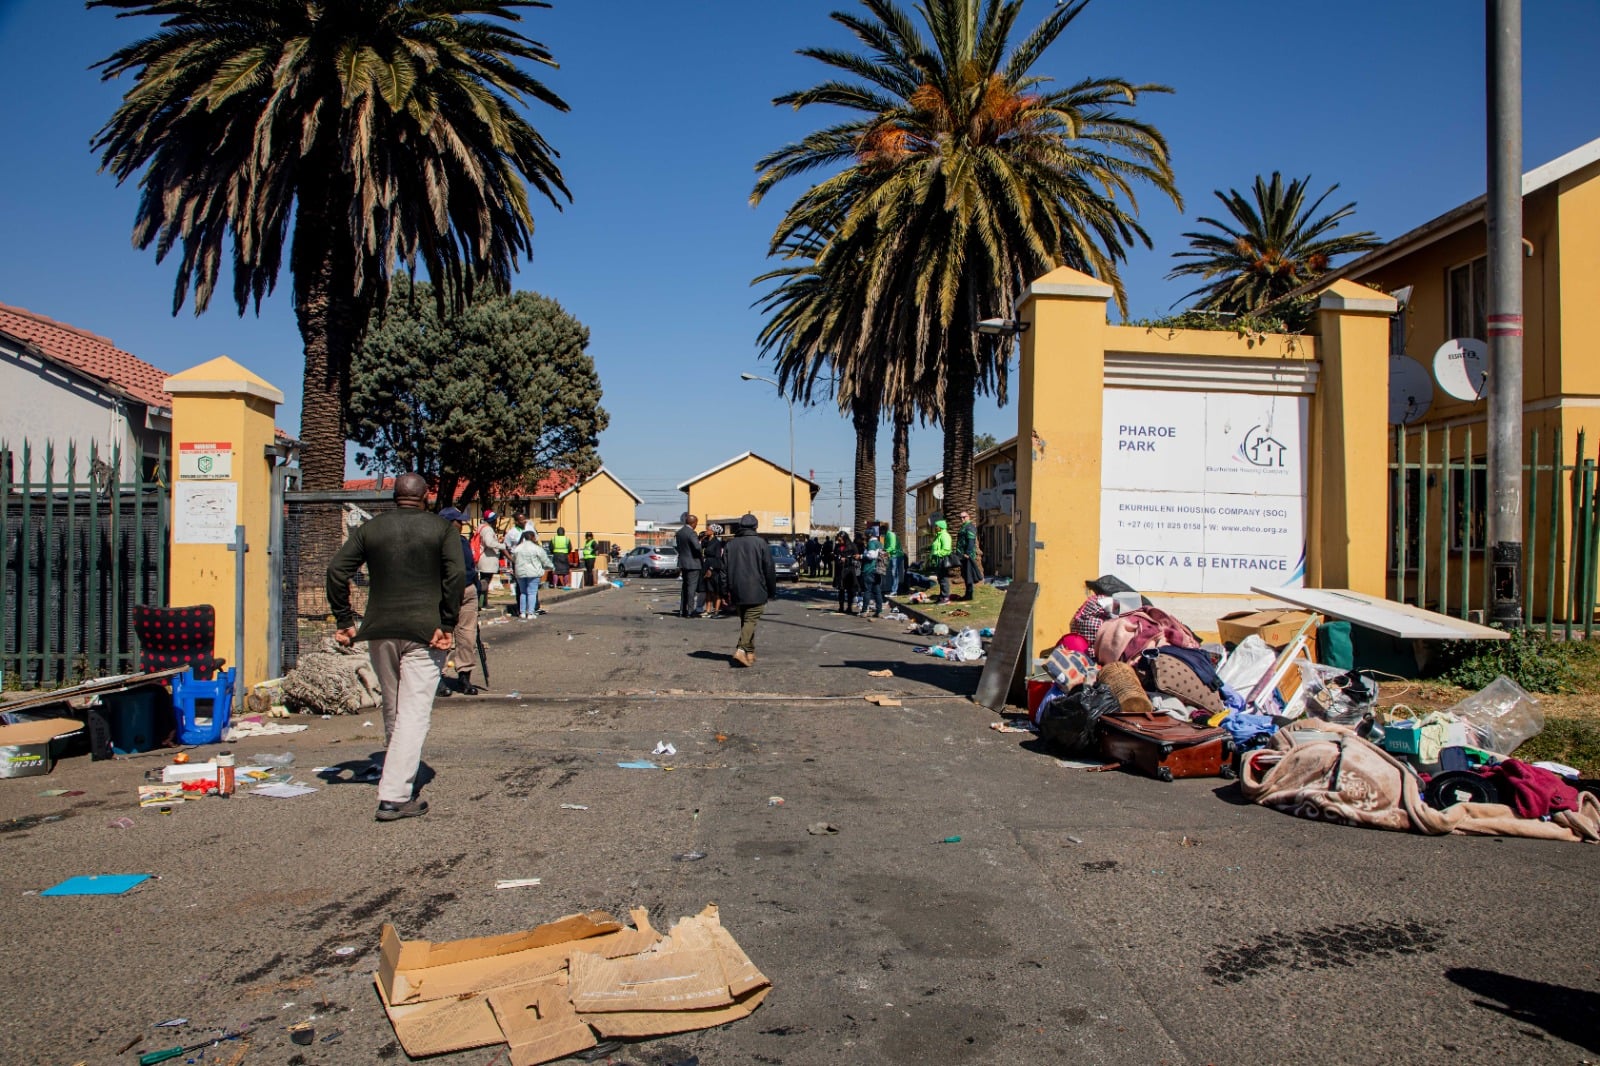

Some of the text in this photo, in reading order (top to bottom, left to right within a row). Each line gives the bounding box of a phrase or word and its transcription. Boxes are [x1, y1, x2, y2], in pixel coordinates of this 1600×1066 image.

[1119, 424, 1176, 438] PHAROE
[1119, 440, 1155, 452] PARK
[1119, 503, 1287, 518] EKURHULENI HOUSING COMPANY (SOC)
[1143, 522, 1153, 530] (0)
[1157, 521, 1164, 529] 11
[1116, 553, 1287, 570] BLOCK A & B ENTRANCE
